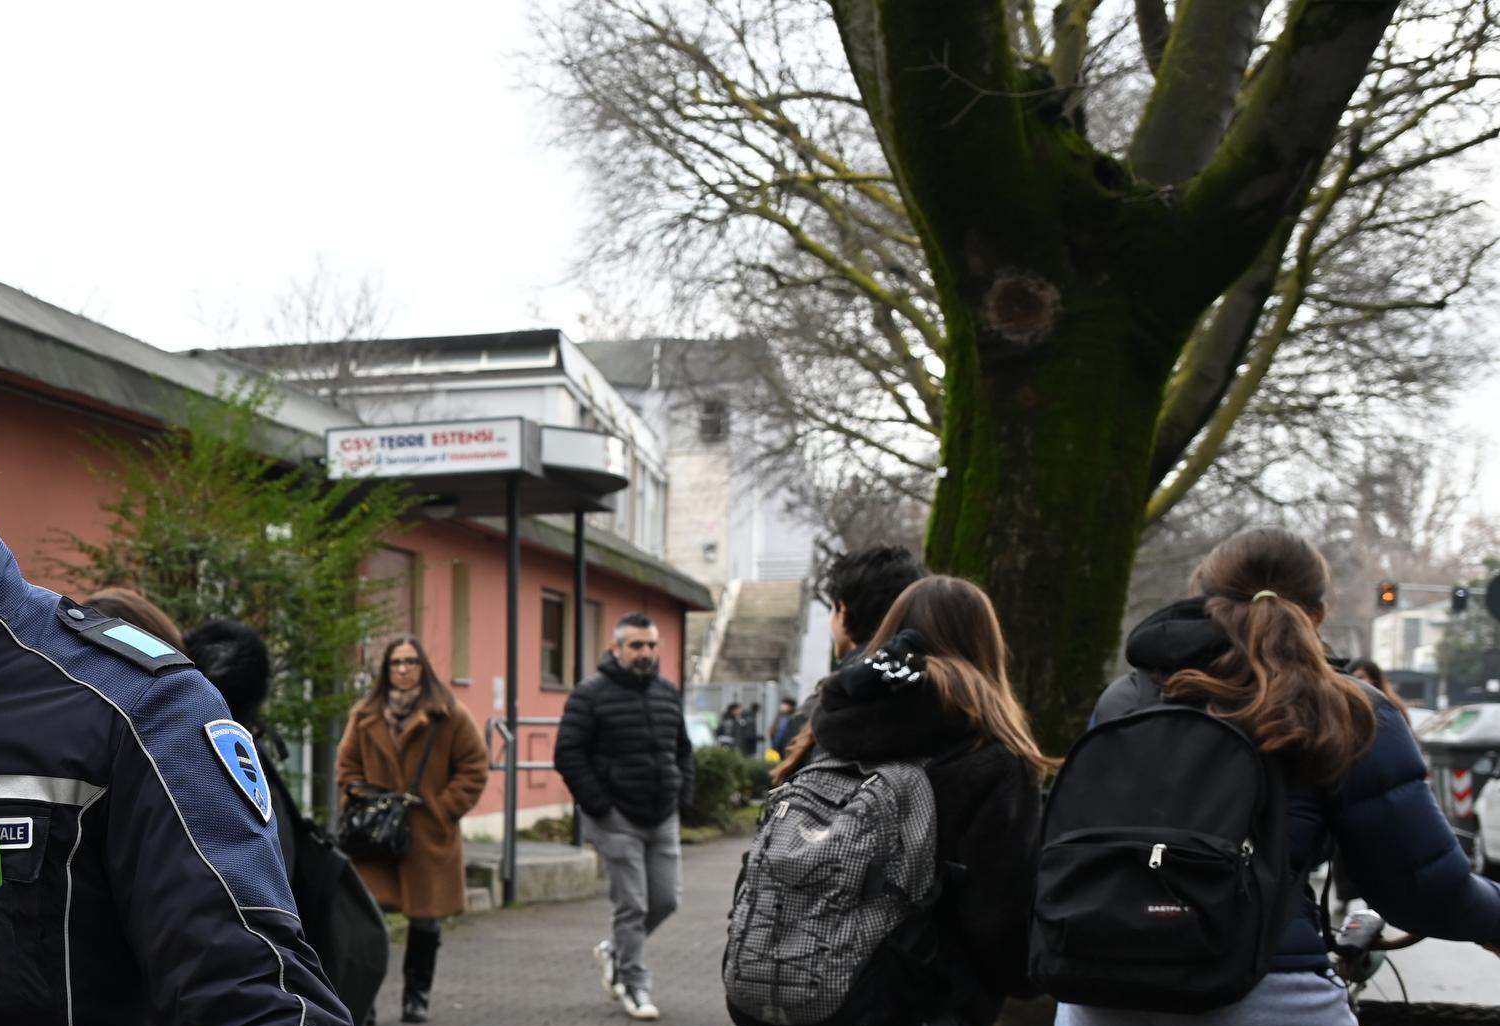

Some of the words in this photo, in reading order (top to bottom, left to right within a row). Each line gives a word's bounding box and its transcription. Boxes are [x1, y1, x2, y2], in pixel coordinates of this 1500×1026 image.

[340, 437, 374, 451] CSV
[379, 433, 425, 449] TERRE
[431, 430, 494, 446] ESTENSI
